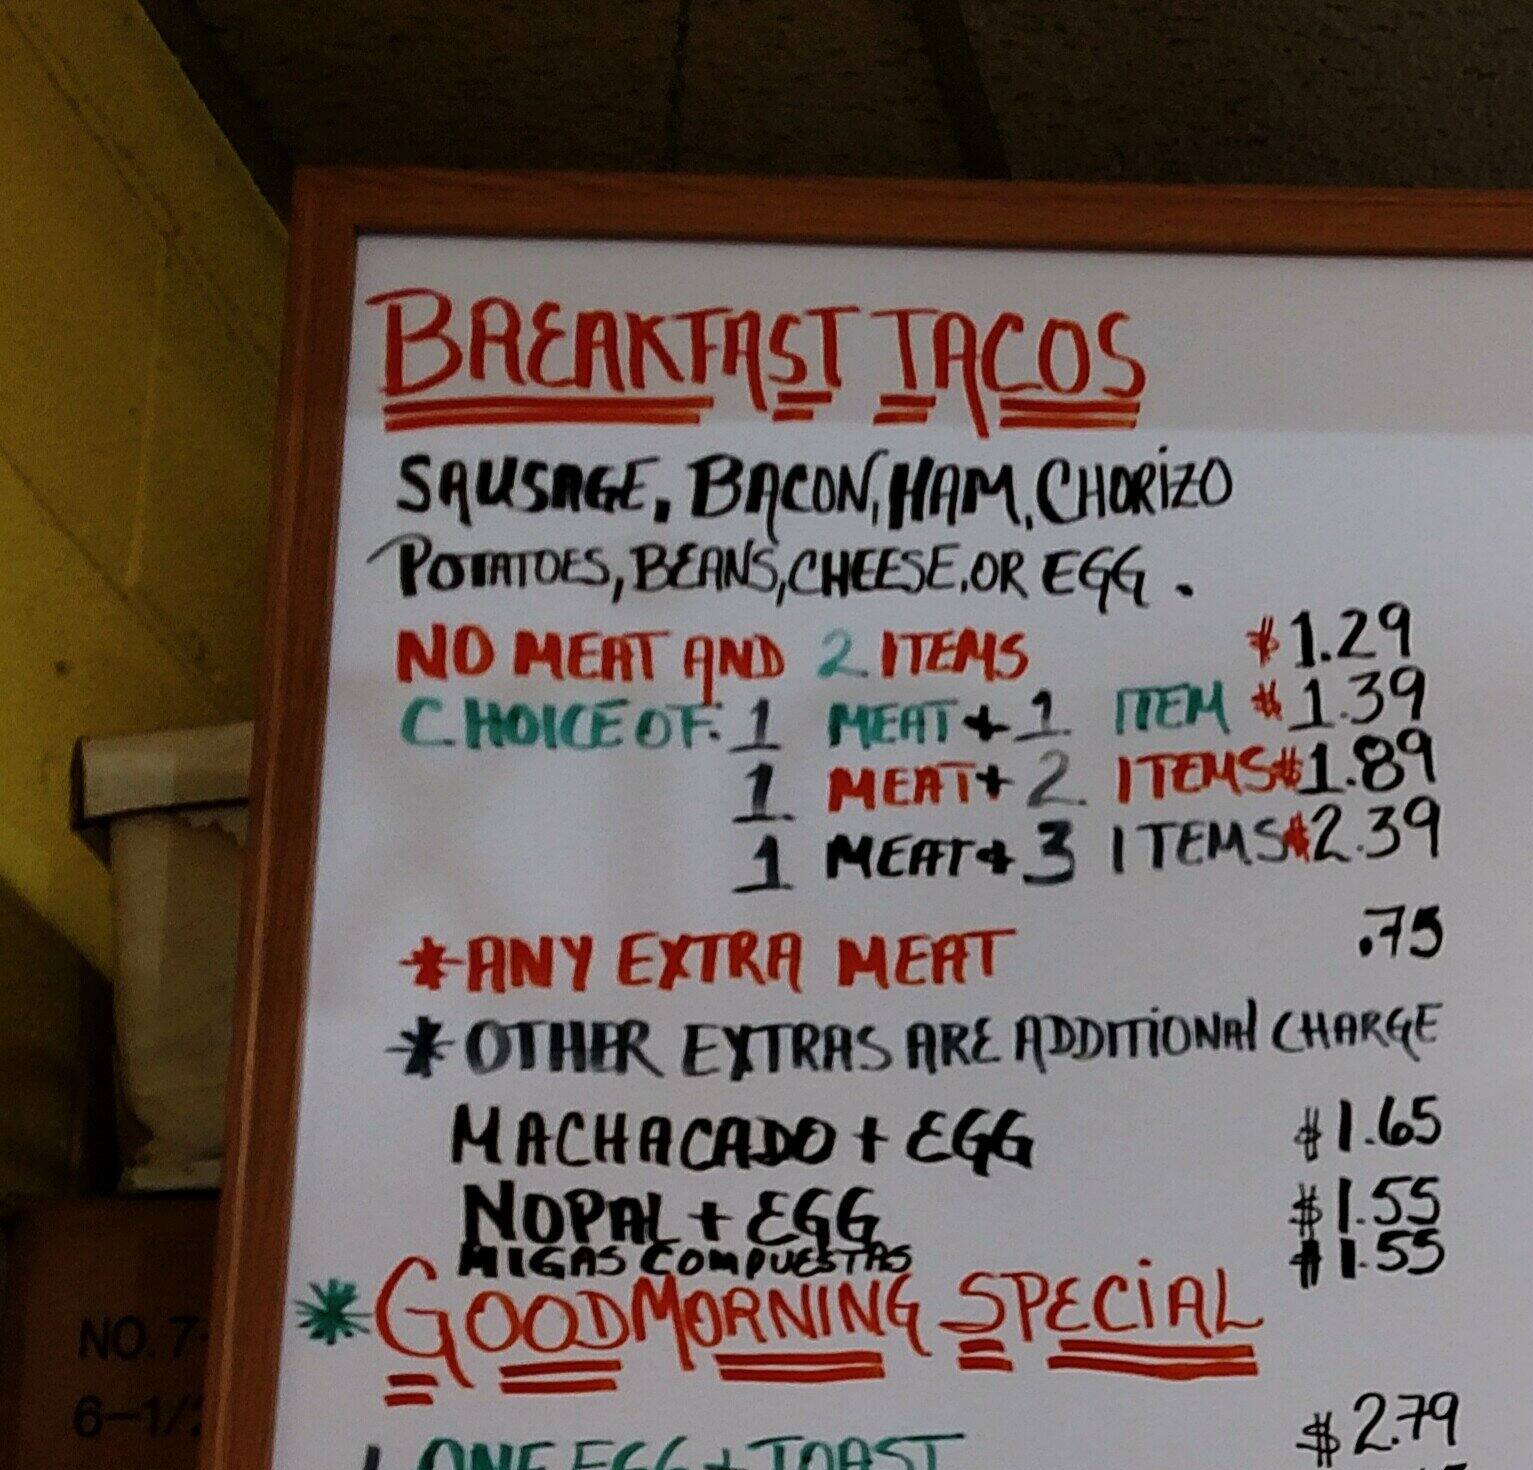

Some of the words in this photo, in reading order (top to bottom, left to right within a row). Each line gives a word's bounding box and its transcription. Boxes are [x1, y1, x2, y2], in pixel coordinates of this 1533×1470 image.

[366, 288, 859, 411] BREAKFAST
[871, 307, 1147, 438] TACOS
[1036, 446, 1233, 526] CHORIZO
[398, 625, 494, 684] NO
[513, 629, 672, 682] MEAT
[684, 635, 785, 704] AND
[817, 629, 868, 680] 2
[882, 628, 1028, 682] ITEMS
[401, 697, 629, 751] CHOICE
[828, 700, 959, 748] MEAT
[1115, 680, 1230, 734] ITEM
[827, 762, 975, 812] MEAT
[1116, 745, 1273, 803] ITEMS
[825, 835, 975, 878] MEAT
[1112, 817, 1285, 873] ITEMS
[618, 931, 802, 995] EXTRA
[838, 928, 1016, 988] MEAT
[1359, 906, 1443, 958] .75
[683, 1023, 893, 1081] EXTRAS
[907, 1020, 1000, 1074] ARE
[1273, 1003, 1443, 1061] CHARGE
[452, 1104, 836, 1170] MACHACADO
[906, 1109, 1034, 1177] EGG
[464, 1181, 681, 1247] NOPAL
[747, 1186, 879, 1248] EGG
[459, 1242, 625, 1278] MIGAS
[641, 1244, 912, 1279] COMPUESTAS
[940, 1258, 1263, 1341] SPECIAL
